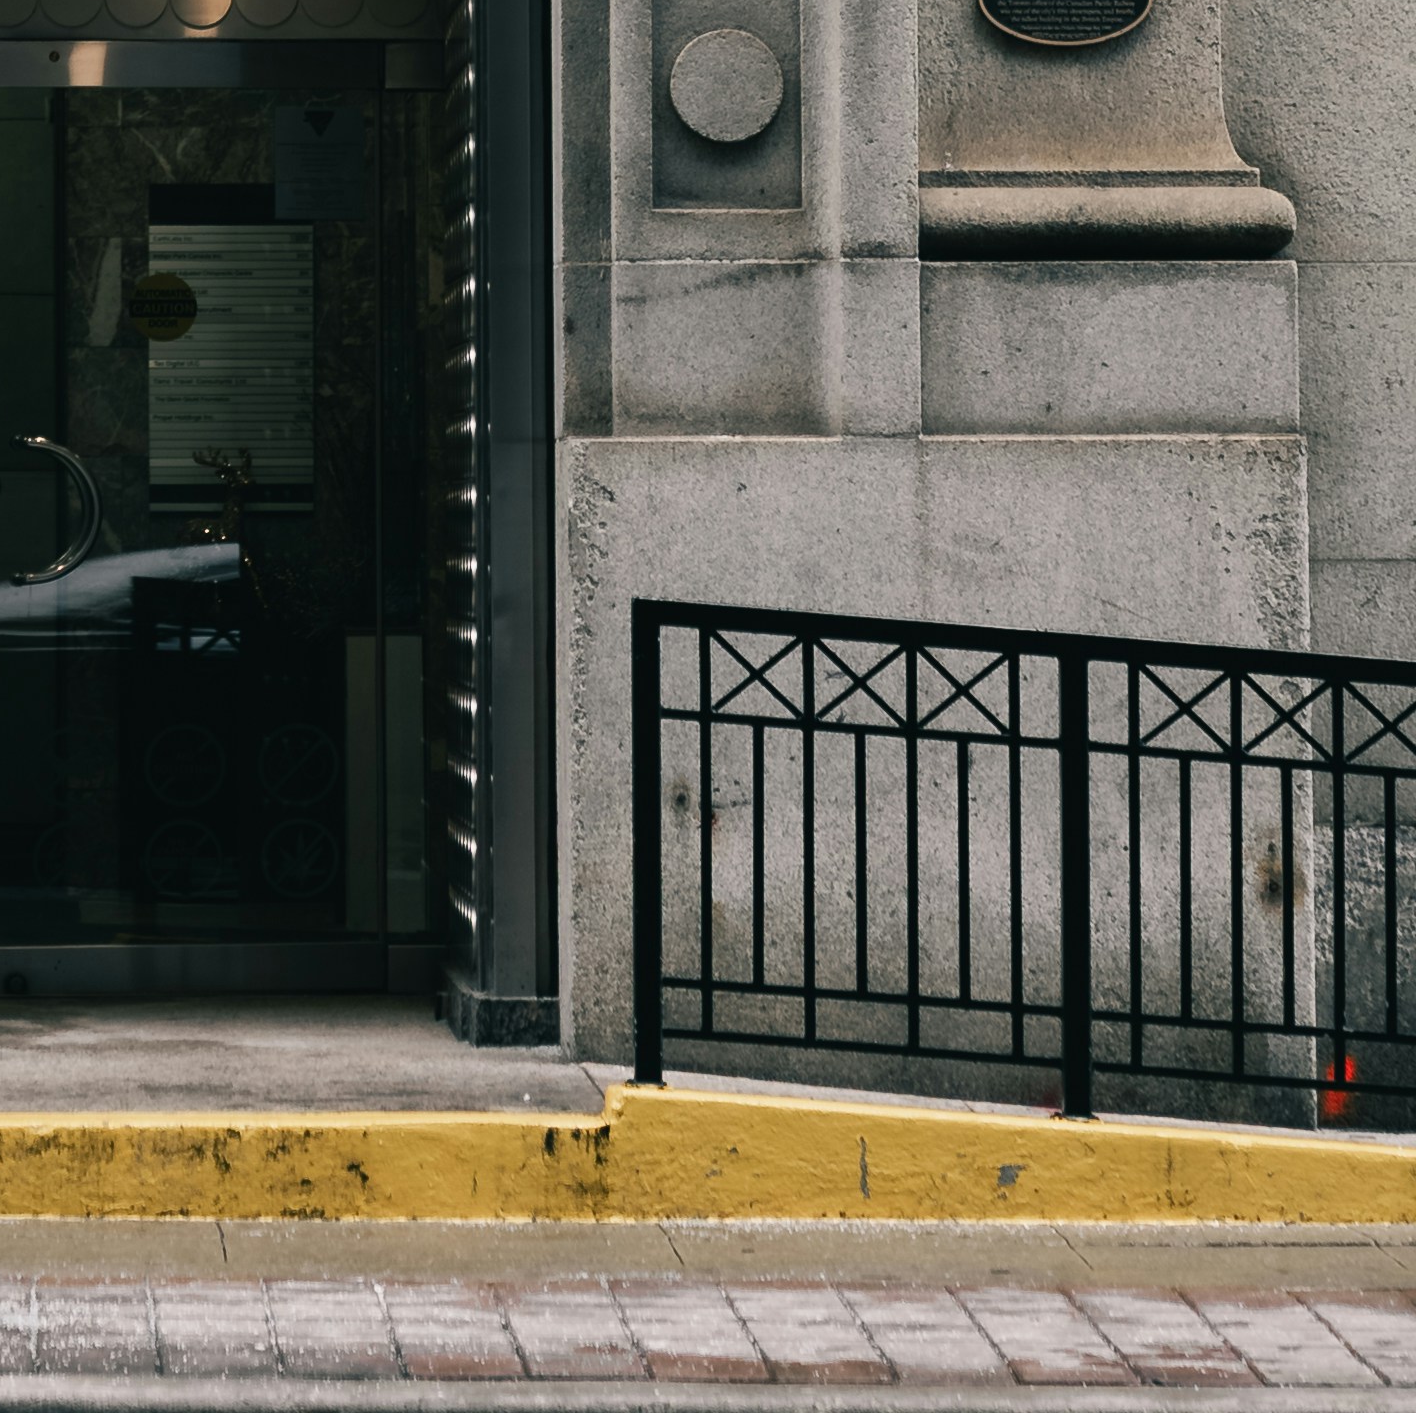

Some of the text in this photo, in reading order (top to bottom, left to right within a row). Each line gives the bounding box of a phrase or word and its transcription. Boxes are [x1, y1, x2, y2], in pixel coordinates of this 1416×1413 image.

[135, 289, 192, 298] AUTOMATIC
[132, 302, 196, 314] CAUTION
[148, 319, 178, 328] DOOR
